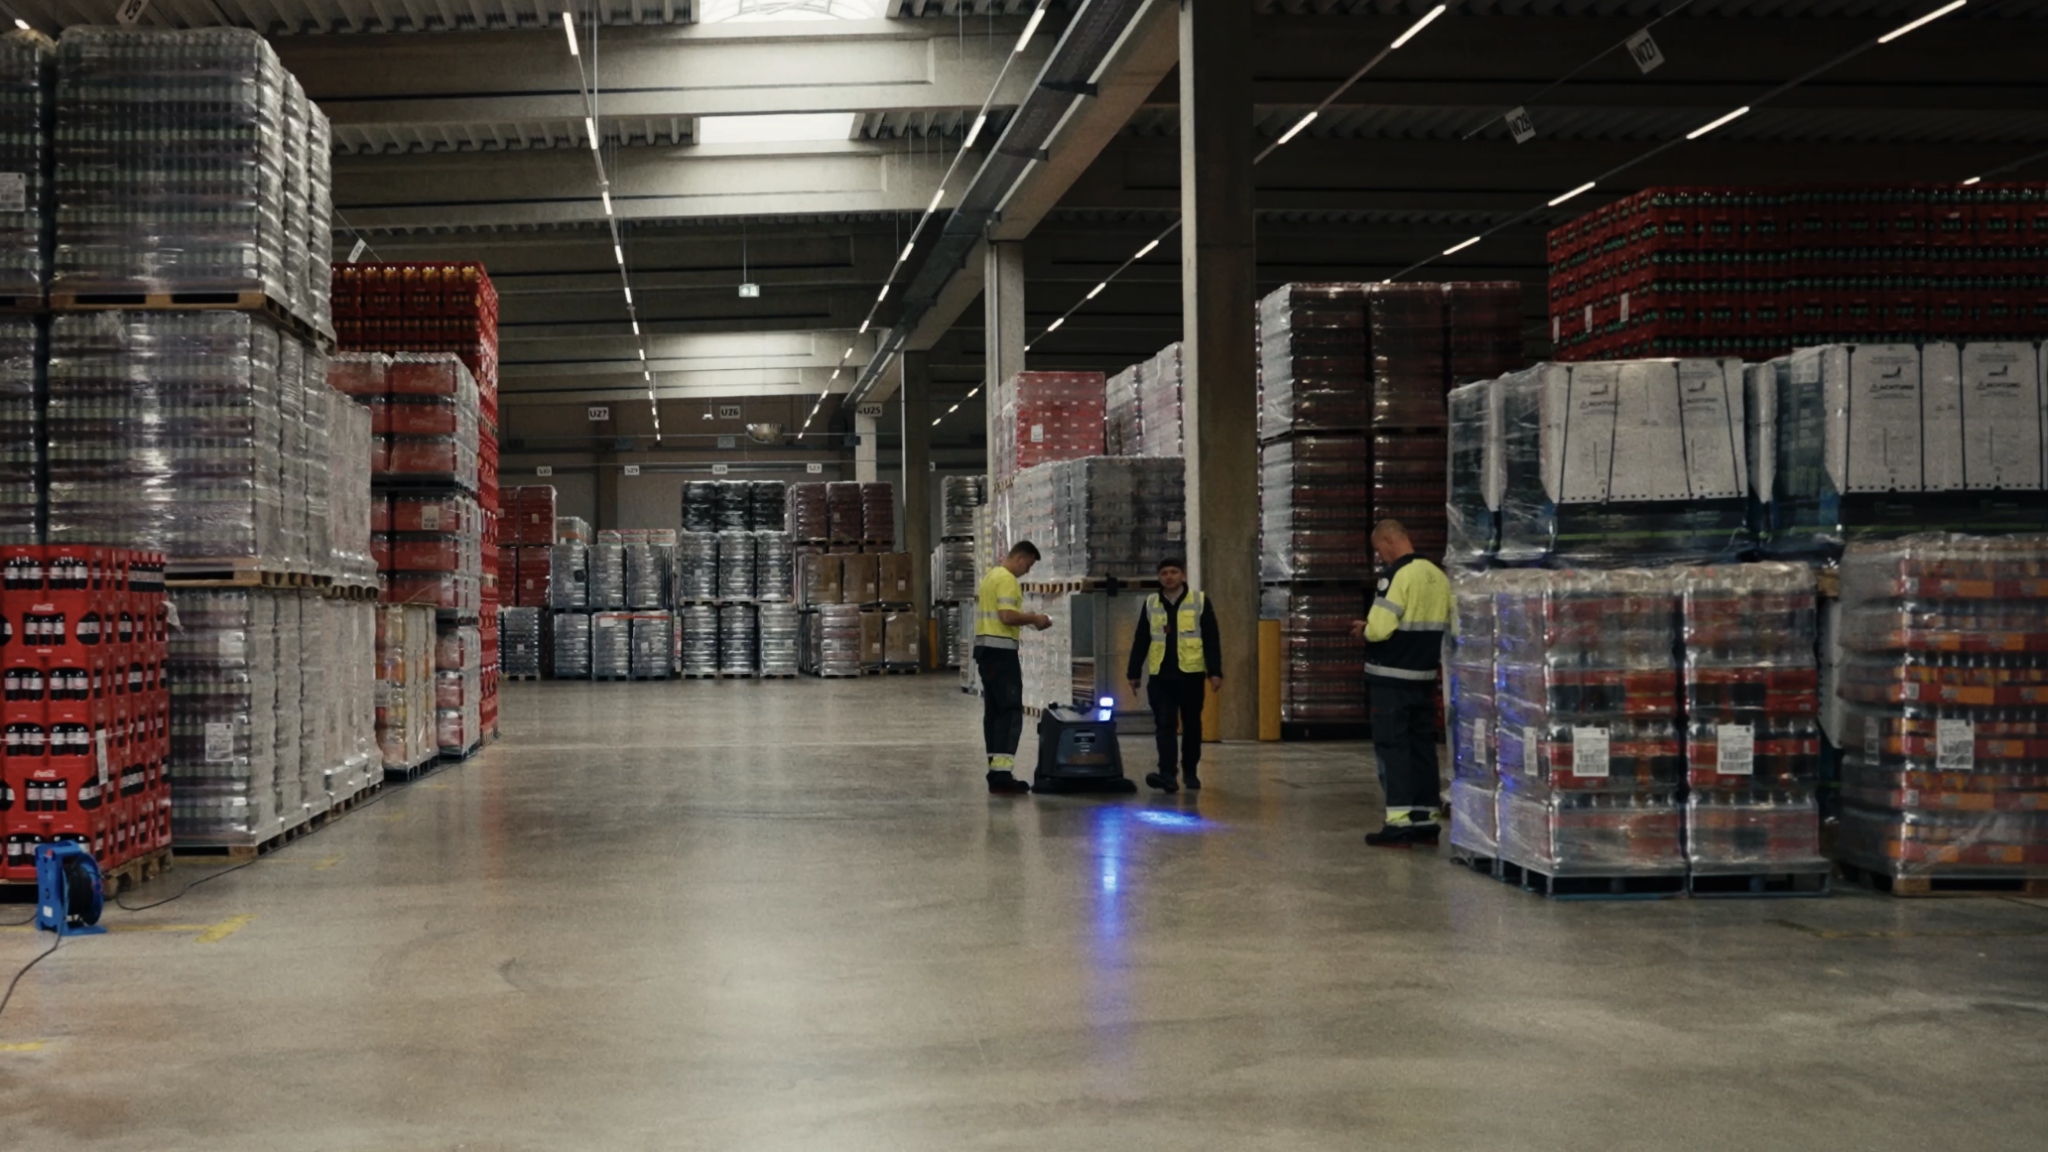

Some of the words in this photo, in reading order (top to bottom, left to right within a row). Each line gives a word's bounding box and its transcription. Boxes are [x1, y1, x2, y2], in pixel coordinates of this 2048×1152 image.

[1631, 38, 1656, 65] W27
[589, 410, 607, 418] U27
[721, 408, 739, 416] U26
[863, 407, 881, 415] U25
